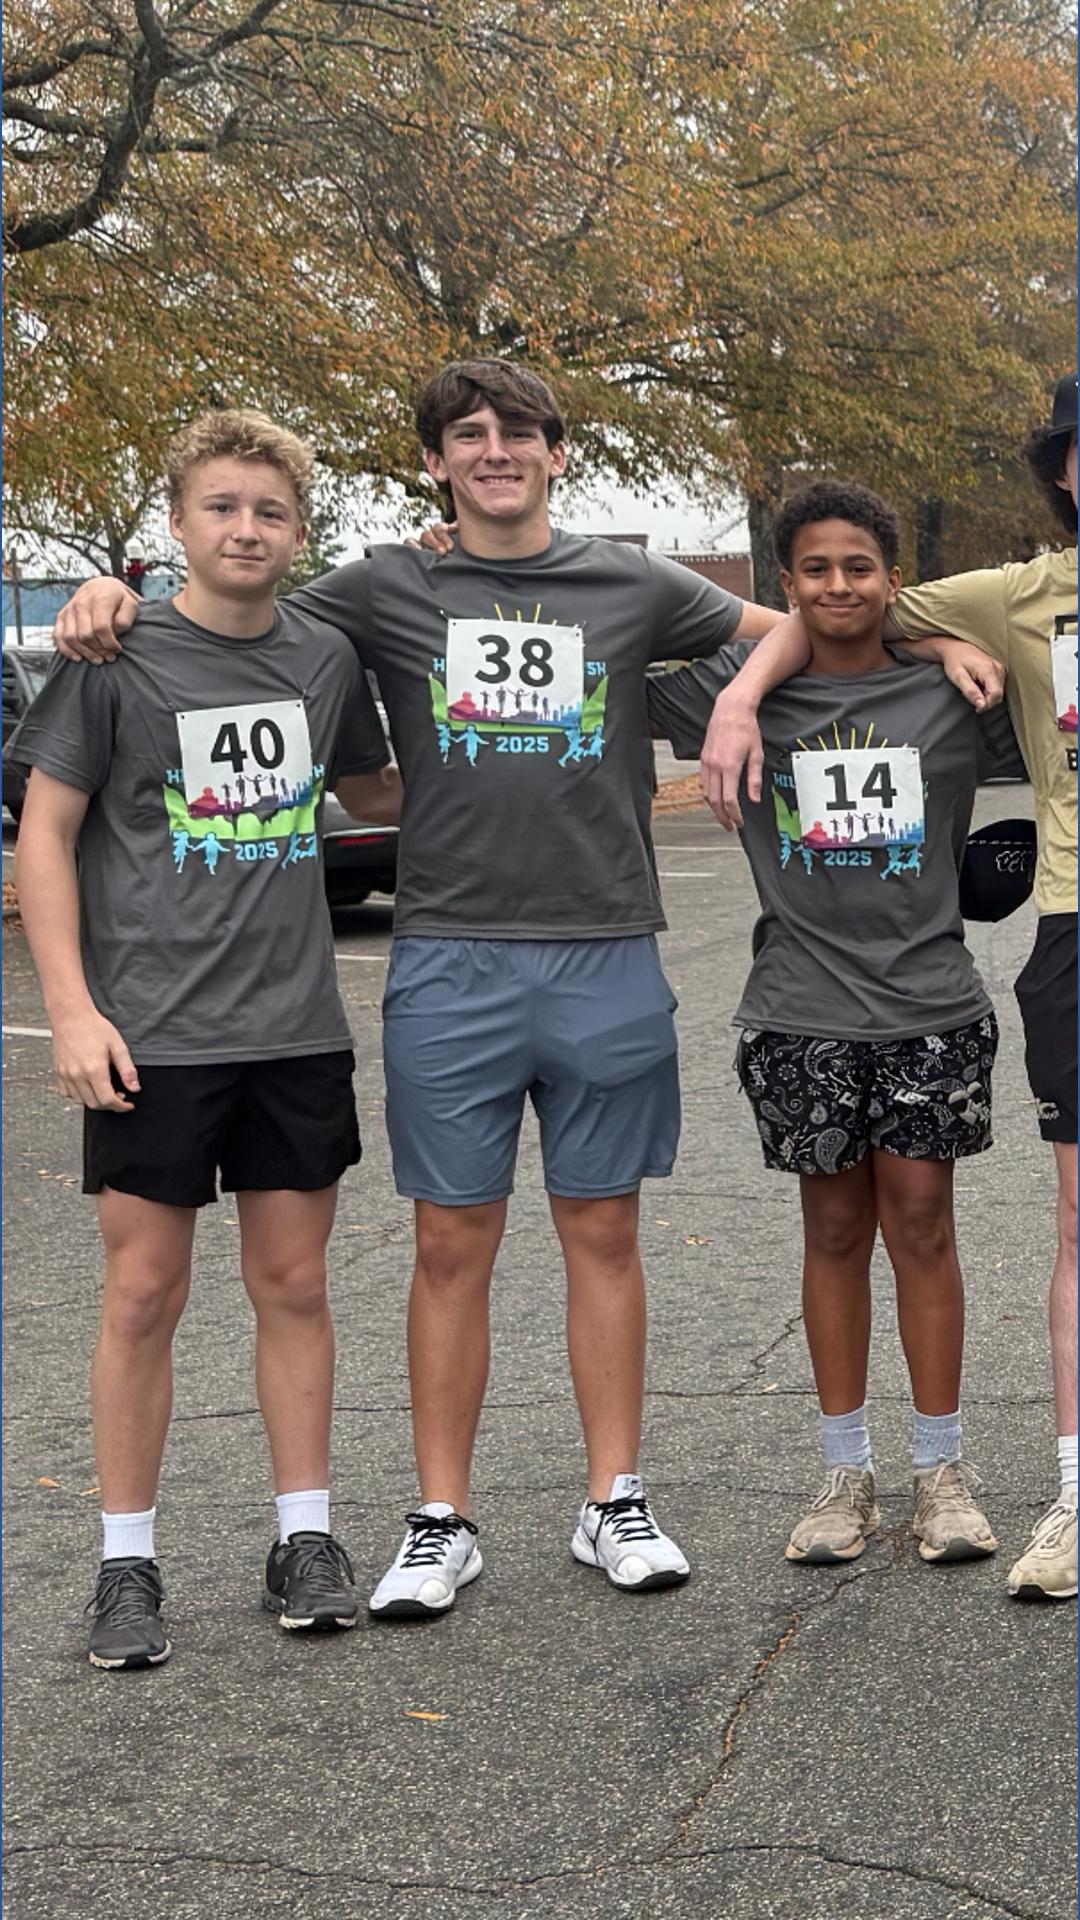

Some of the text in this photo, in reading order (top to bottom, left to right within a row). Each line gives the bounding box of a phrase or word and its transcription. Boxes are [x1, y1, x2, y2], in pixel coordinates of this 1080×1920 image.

[474, 634, 555, 688] 38
[210, 717, 285, 774] 40
[496, 735, 550, 753] 2025
[823, 761, 899, 811] 14
[234, 840, 280, 861] 2025
[823, 850, 873, 867] 2025
